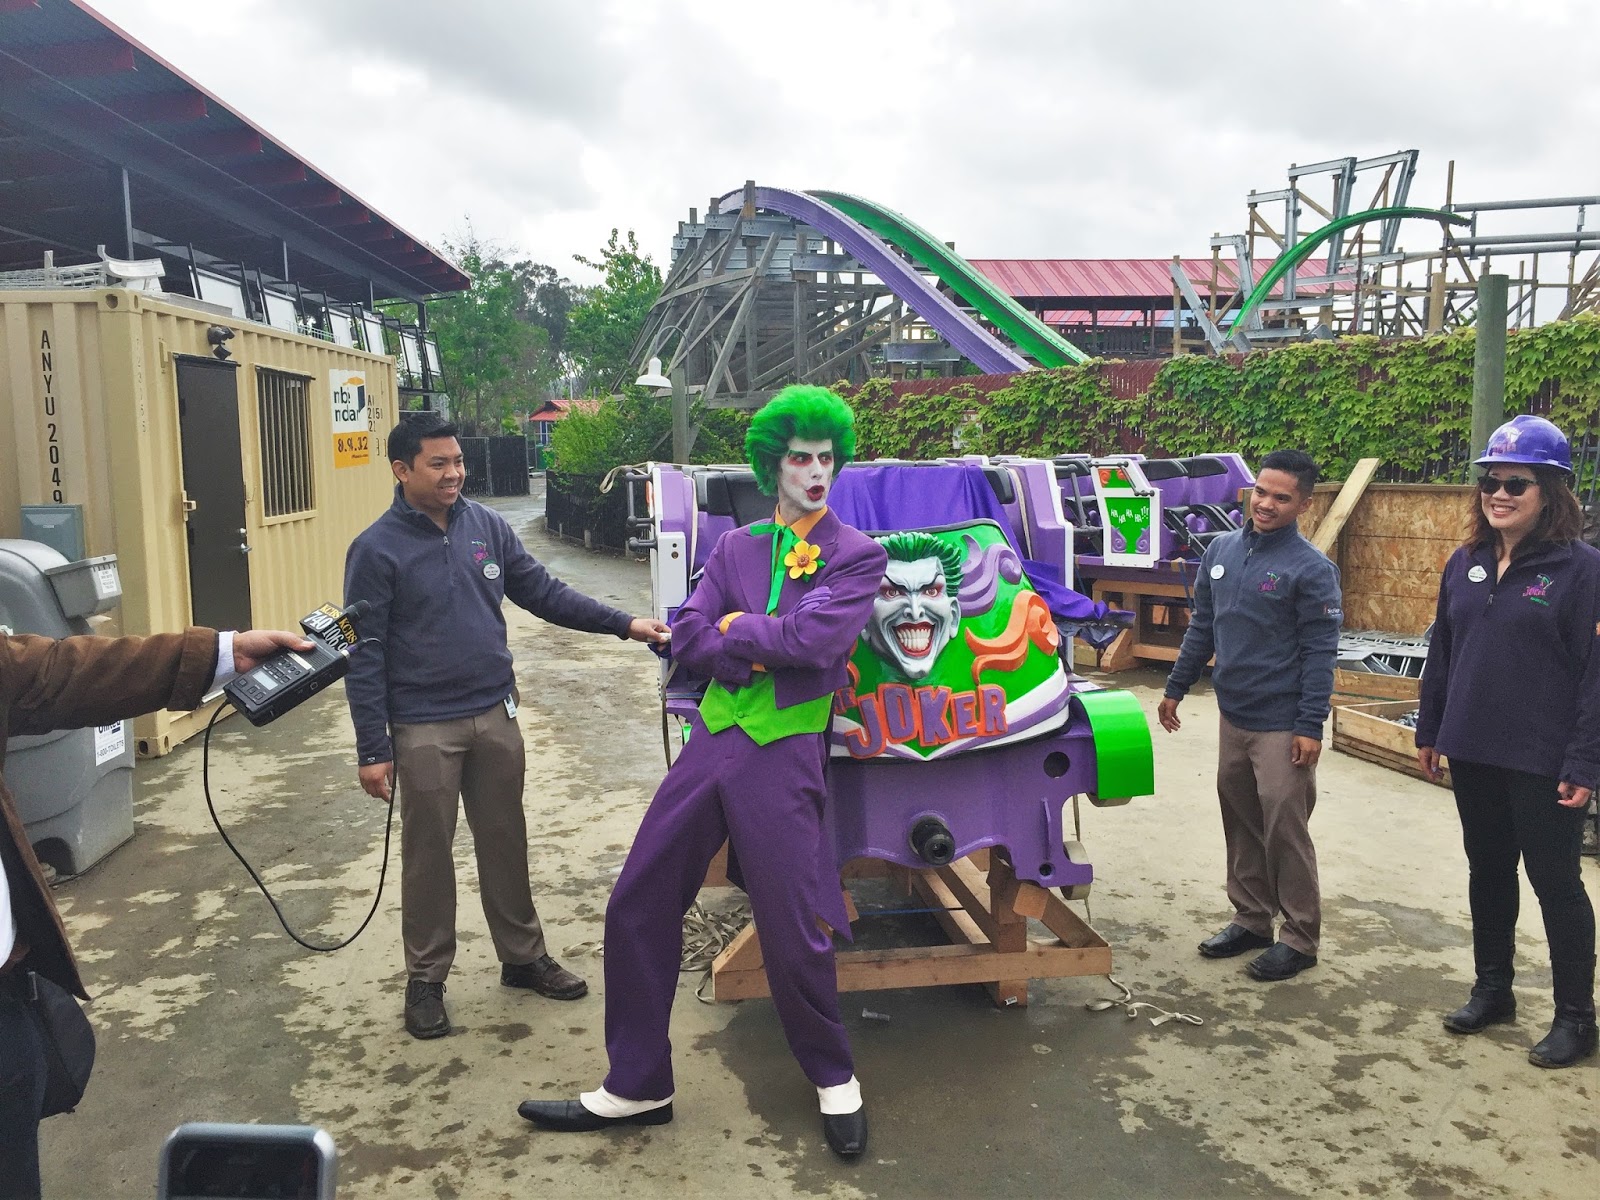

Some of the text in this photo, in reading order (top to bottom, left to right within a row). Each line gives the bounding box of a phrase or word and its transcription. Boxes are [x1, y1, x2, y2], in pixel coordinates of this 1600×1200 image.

[303, 610, 333, 630] 740
[320, 604, 343, 619] KCBS
[338, 616, 358, 644] KCBS
[845, 683, 1008, 759] JOKER
